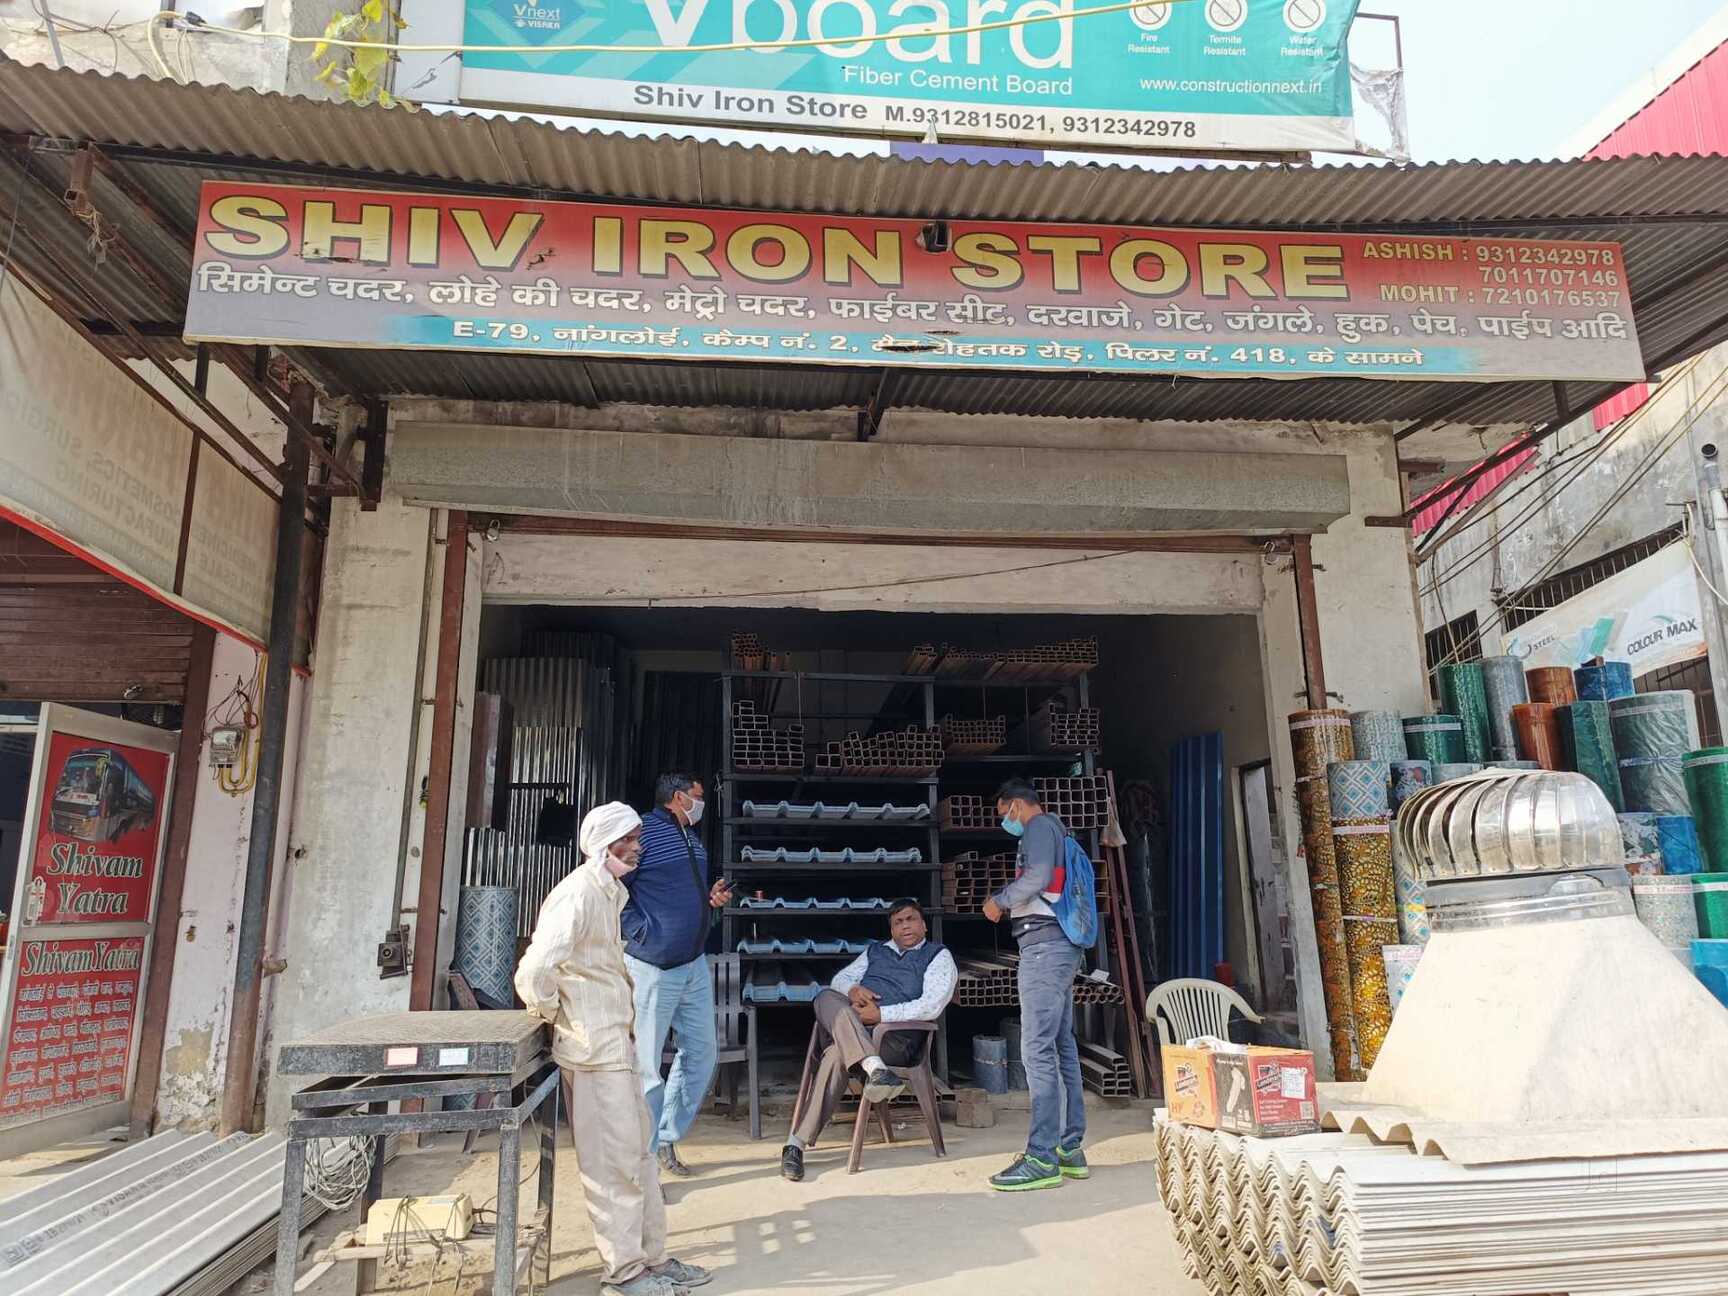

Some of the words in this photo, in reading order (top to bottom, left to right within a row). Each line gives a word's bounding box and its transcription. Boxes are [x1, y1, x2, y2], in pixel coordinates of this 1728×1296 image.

[1128, 44, 1170, 54] Resistant
[1140, 33, 1158, 42] Fire
[1209, 35, 1242, 44] Termite
[1289, 35, 1316, 45] Water
[1204, 46, 1246, 56] Resistant
[1280, 46, 1324, 57] Resistant
[844, 65, 901, 86] Fiber
[909, 69, 999, 92] Cement
[1006, 75, 1073, 96] Board
[1139, 77, 1322, 94] www.constructionnext.in
[633, 84, 705, 109] Shiv
[714, 90, 775, 114] Iron
[785, 94, 869, 120] Store
[1062, 115, 1197, 138] 9312342978
[203, 194, 545, 272] SHIV
[591, 215, 904, 288] IRON
[950, 232, 1350, 303] STORE
[1363, 241, 1454, 261] ASHISH
[1475, 246, 1616, 266] 9312342978
[1478, 266, 1619, 287] 7011707146
[198, 261, 321, 298] सिमेन्ट
[428, 274, 502, 308] लोहे
[511, 277, 562, 308] की
[664, 283, 728, 321] मेट्रो
[829, 293, 939, 323] फाईबर
[1026, 300, 1145, 331] दरवाजे,
[1153, 303, 1214, 333] गेट,
[1223, 305, 1325, 334] जंगले,
[1477, 310, 1553, 341] पाईप
[1562, 311, 1629, 340] आदि
[1380, 284, 1459, 304] MOHIT
[1481, 287, 1622, 309] 7210176537
[452, 320, 542, 343] E-79,
[1104, 343, 1179, 363] पिलर
[1306, 347, 1336, 364] के
[1344, 348, 1425, 366] सामने
[1626, 628, 1664, 657] COLOUR
[1666, 618, 1699, 641] MAX
[46, 842, 145, 878] Shivam
[57, 881, 129, 915] Yatra
